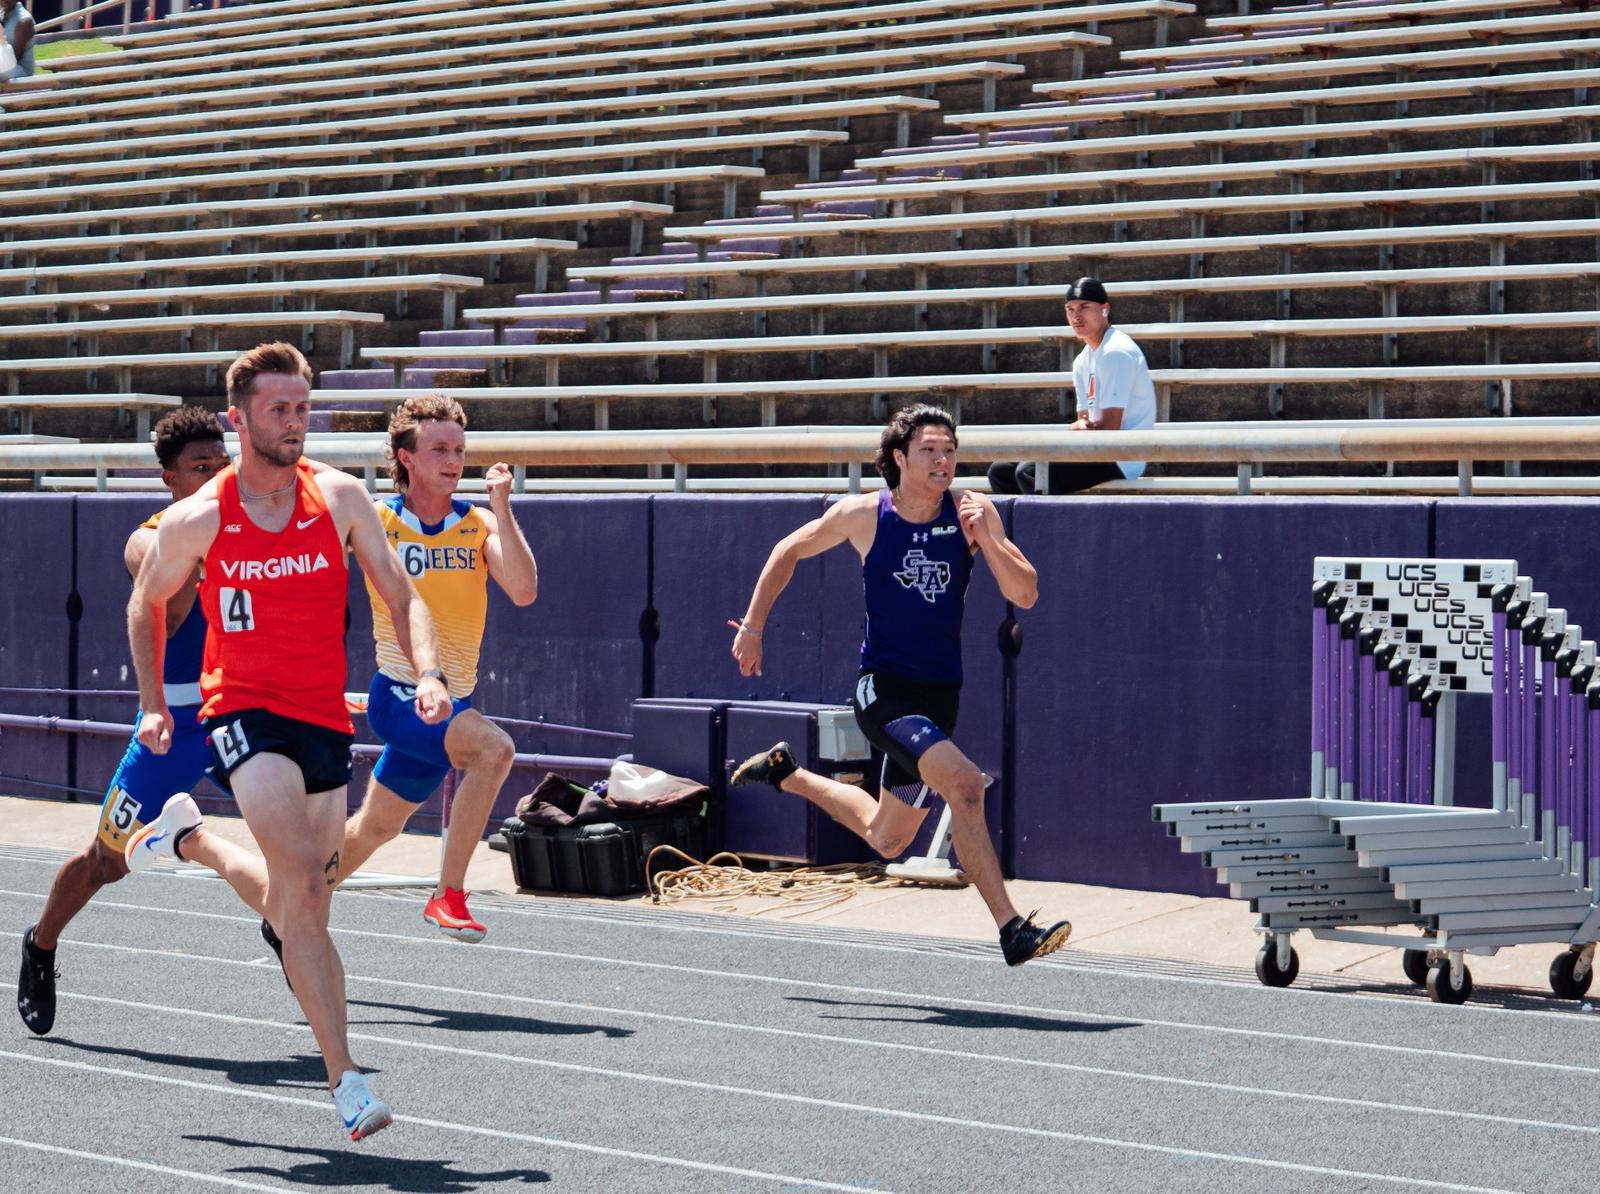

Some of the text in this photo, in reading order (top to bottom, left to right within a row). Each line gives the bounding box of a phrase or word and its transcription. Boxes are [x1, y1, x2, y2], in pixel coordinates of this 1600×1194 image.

[220, 551, 330, 581] VIRGINIA
[404, 544, 423, 576] 6
[1386, 563, 1437, 581] UCS
[1398, 581, 1450, 597] UCS
[228, 588, 251, 630] 4
[1414, 598, 1466, 613] UCS
[1433, 613, 1485, 629] UCS
[1448, 630, 1493, 645] UCS
[1462, 646, 1493, 660] UC
[222, 725, 244, 757] 4
[114, 796, 138, 830] 5
